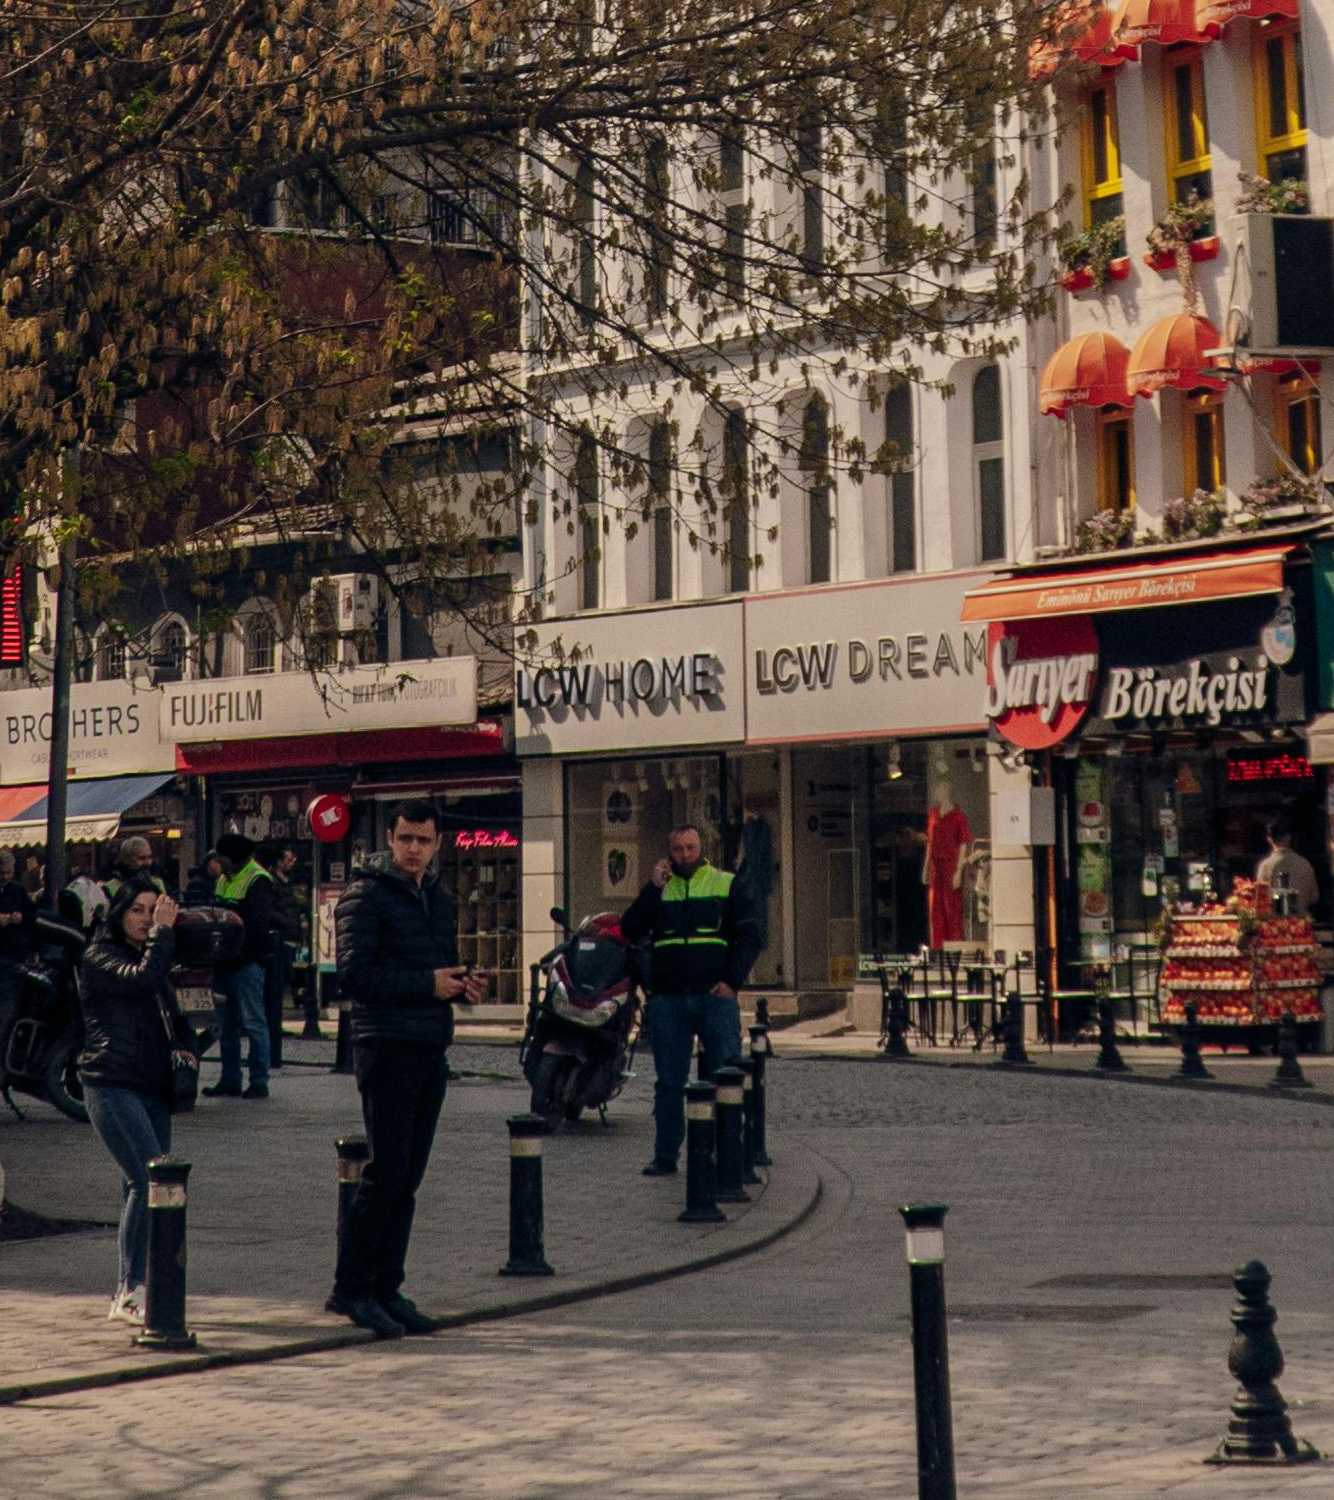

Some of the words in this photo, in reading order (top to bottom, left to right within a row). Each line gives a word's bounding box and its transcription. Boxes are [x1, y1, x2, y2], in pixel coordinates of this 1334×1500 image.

[517, 664, 594, 708] LCW
[605, 653, 713, 702] HOME
[755, 642, 835, 692] LCW
[848, 627, 987, 684] DREAM
[986, 638, 1096, 724] Sarıyer
[1104, 655, 1269, 725] Börekçisi
[6, 703, 140, 744] BROHERS
[171, 688, 263, 728] FUJIFILM
